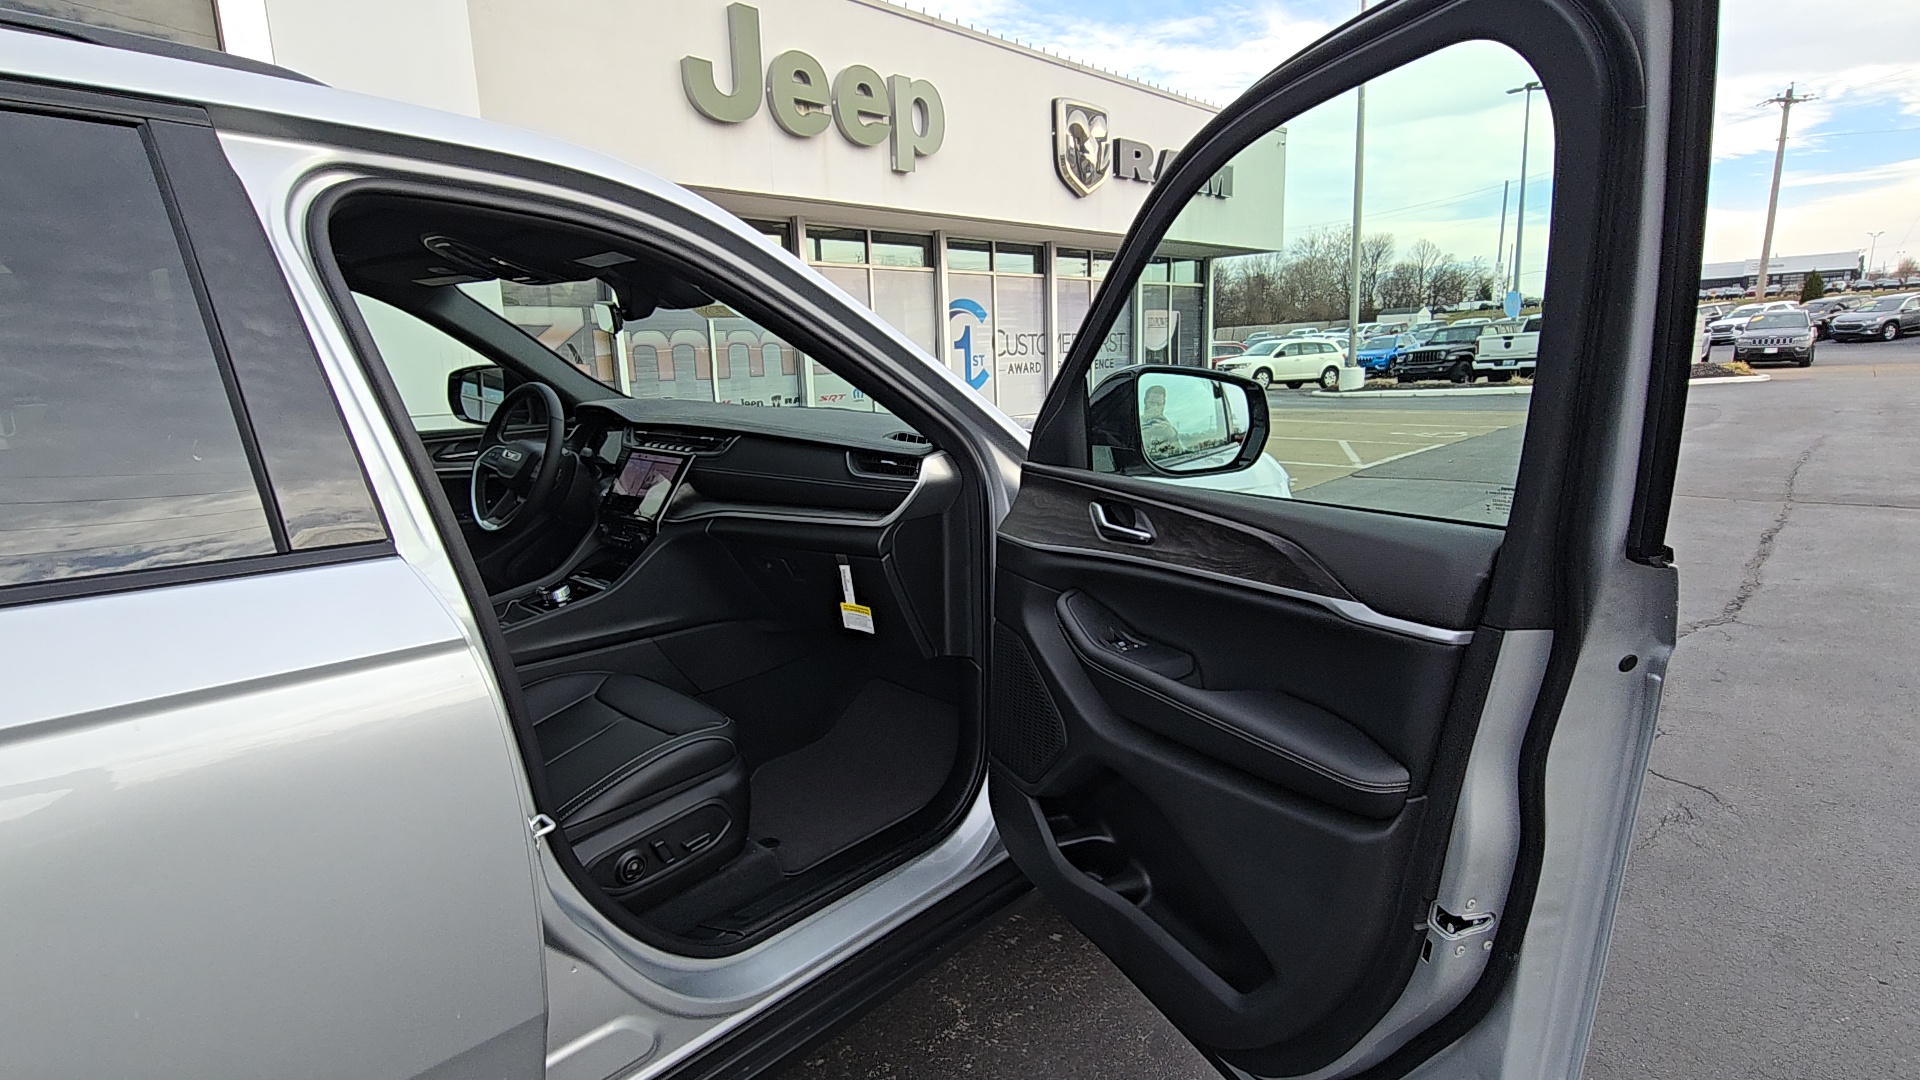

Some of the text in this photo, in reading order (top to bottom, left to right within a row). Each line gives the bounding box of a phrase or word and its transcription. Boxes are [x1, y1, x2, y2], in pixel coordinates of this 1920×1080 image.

[680, 2, 945, 173] Jeep
[1007, 361, 1042, 375] AWARD
[819, 394, 847, 403] SRT
